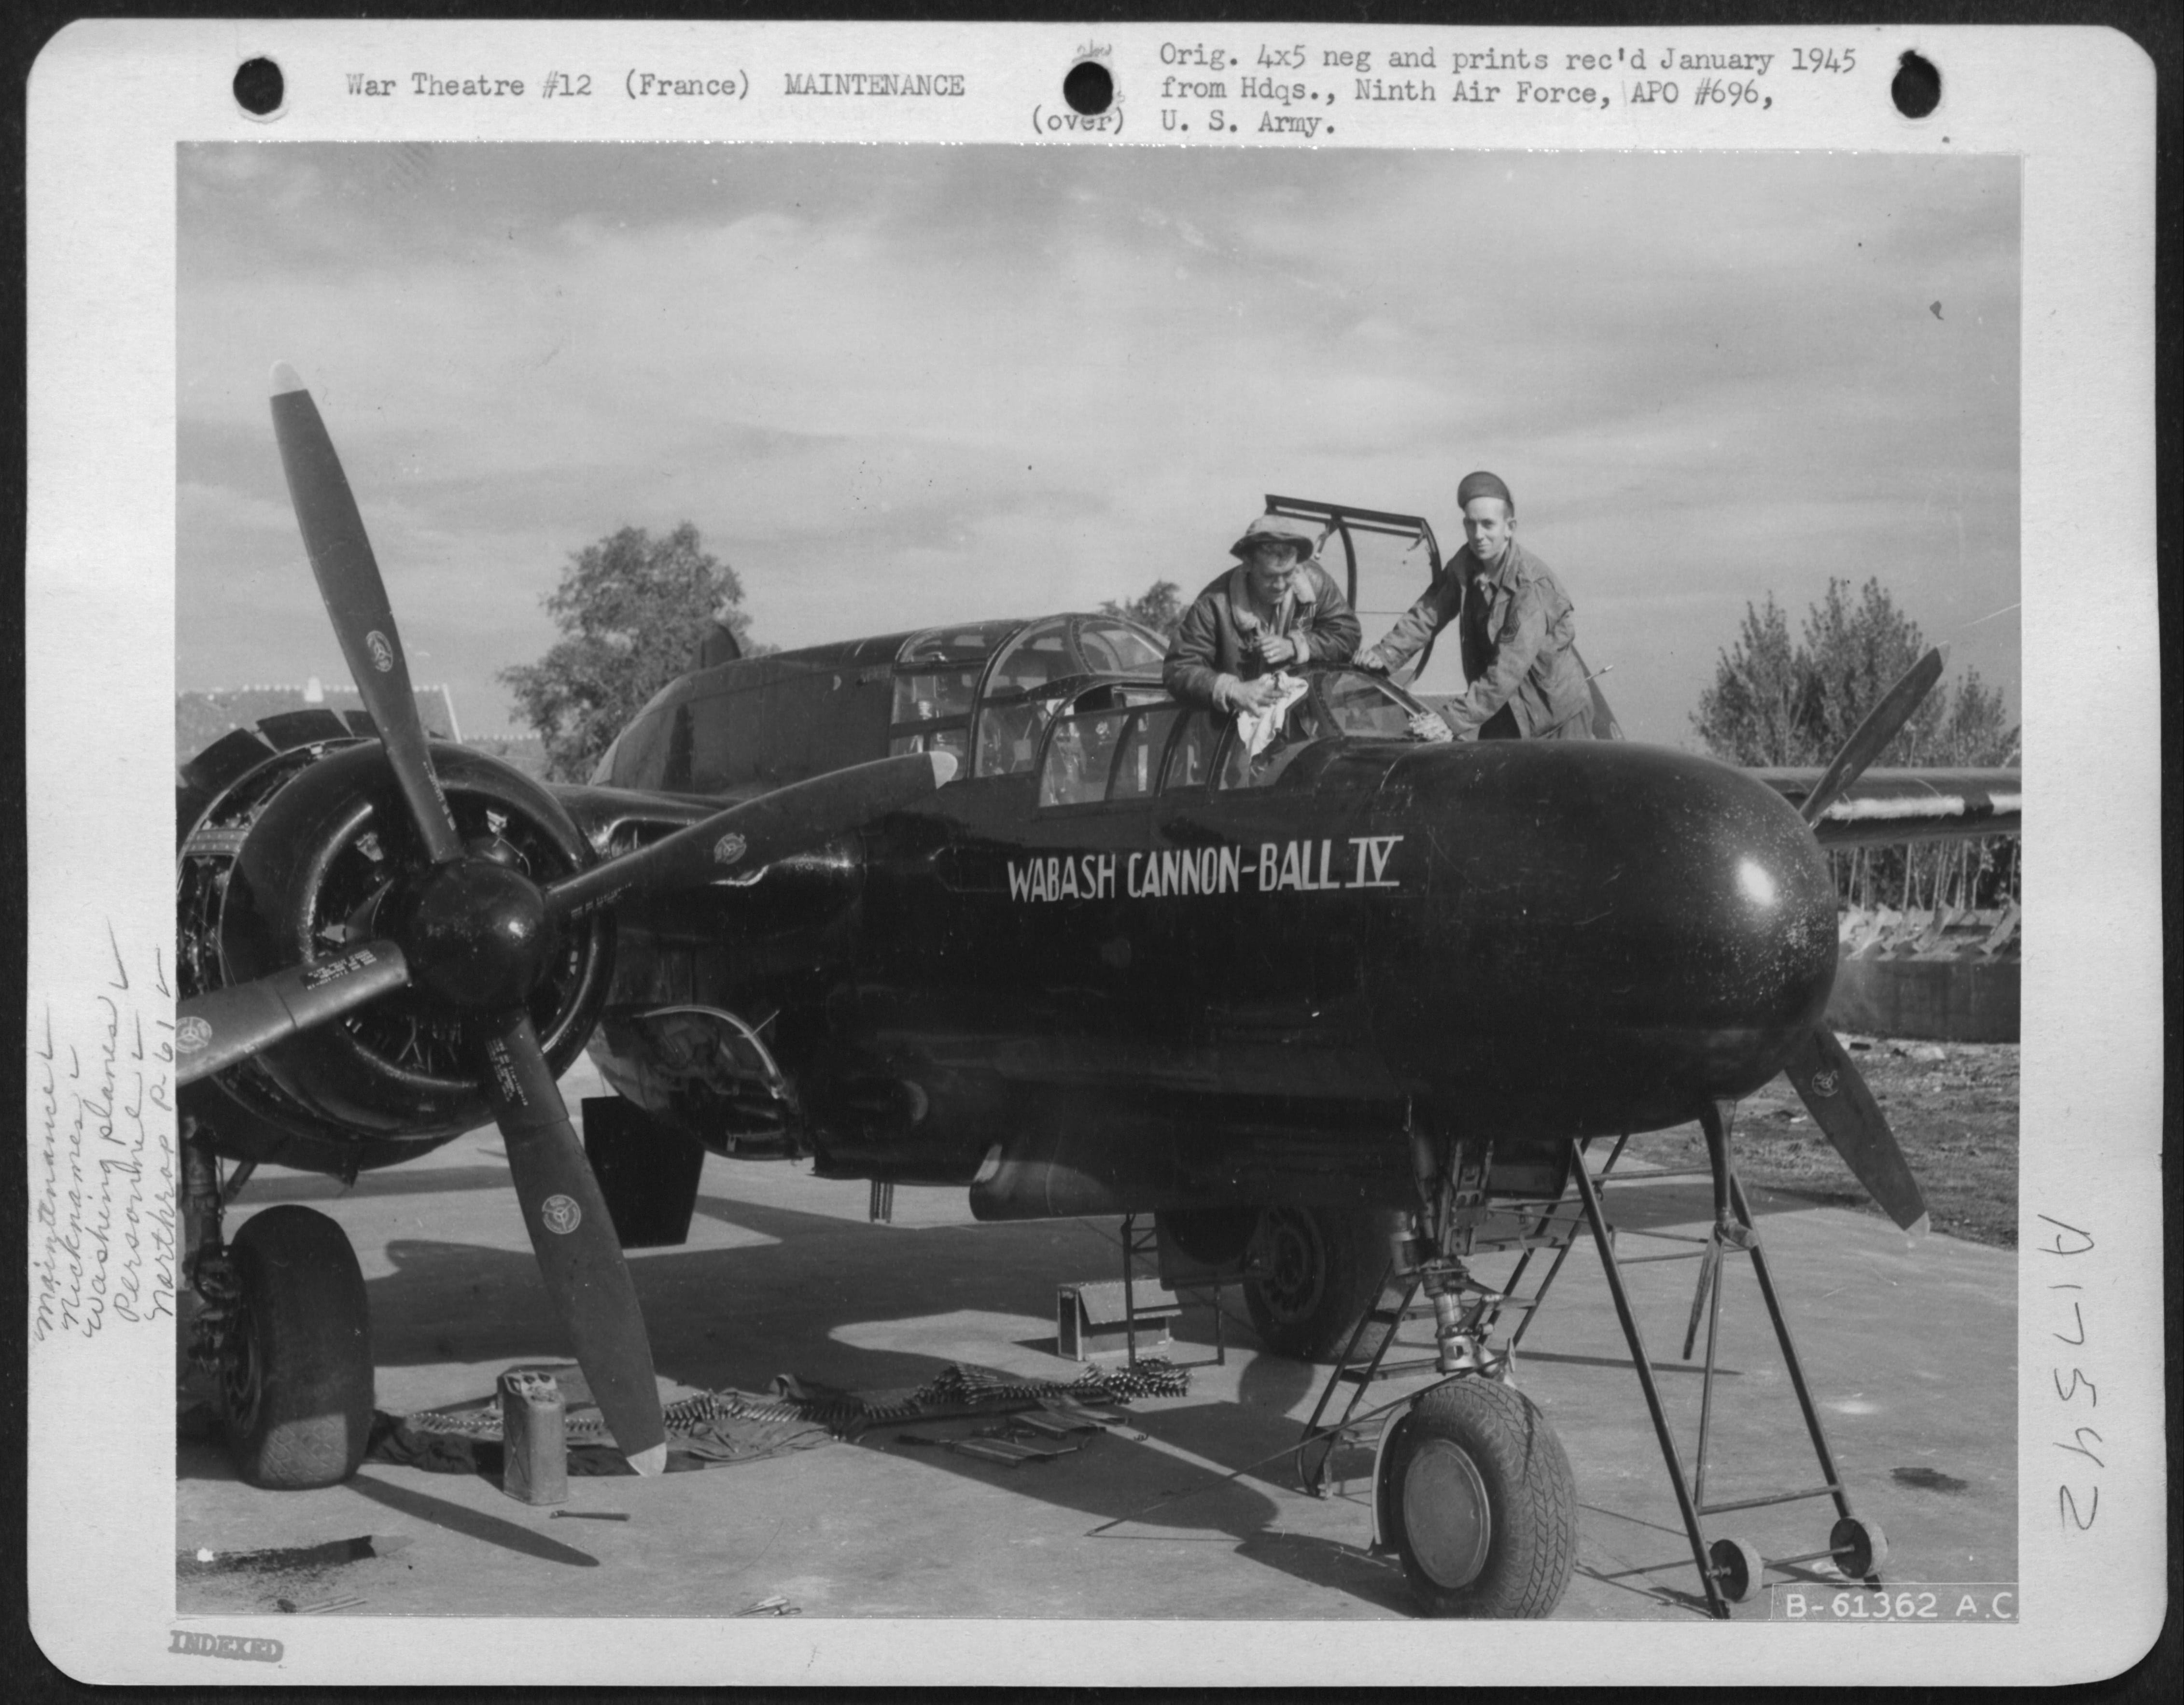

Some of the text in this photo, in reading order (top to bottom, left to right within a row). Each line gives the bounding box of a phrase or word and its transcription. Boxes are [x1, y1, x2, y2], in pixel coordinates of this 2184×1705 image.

[346, 68, 965, 100] War Theatre #12 (France) MAINTENANCE
[1160, 44, 1856, 76] Orig. 4x5 neg and prints rec'd January 1945
[1161, 76, 1773, 108] from Hdqs., Ninth Air Force, APO #696,
[1033, 104, 1123, 135] (over)
[1161, 109, 1335, 139] U. S. Army.
[1008, 835, 1404, 902] WABASH CANNON-BALL IV
[150, 1020, 175, 1112] P-61
[83, 996, 141, 1338] Washing planes
[33, 1062, 58, 1341] Maintenance
[56, 1092, 83, 1331] Nicknames
[2037, 1213, 2105, 1531] A17542
[168, 1630, 284, 1663] INDEXED
